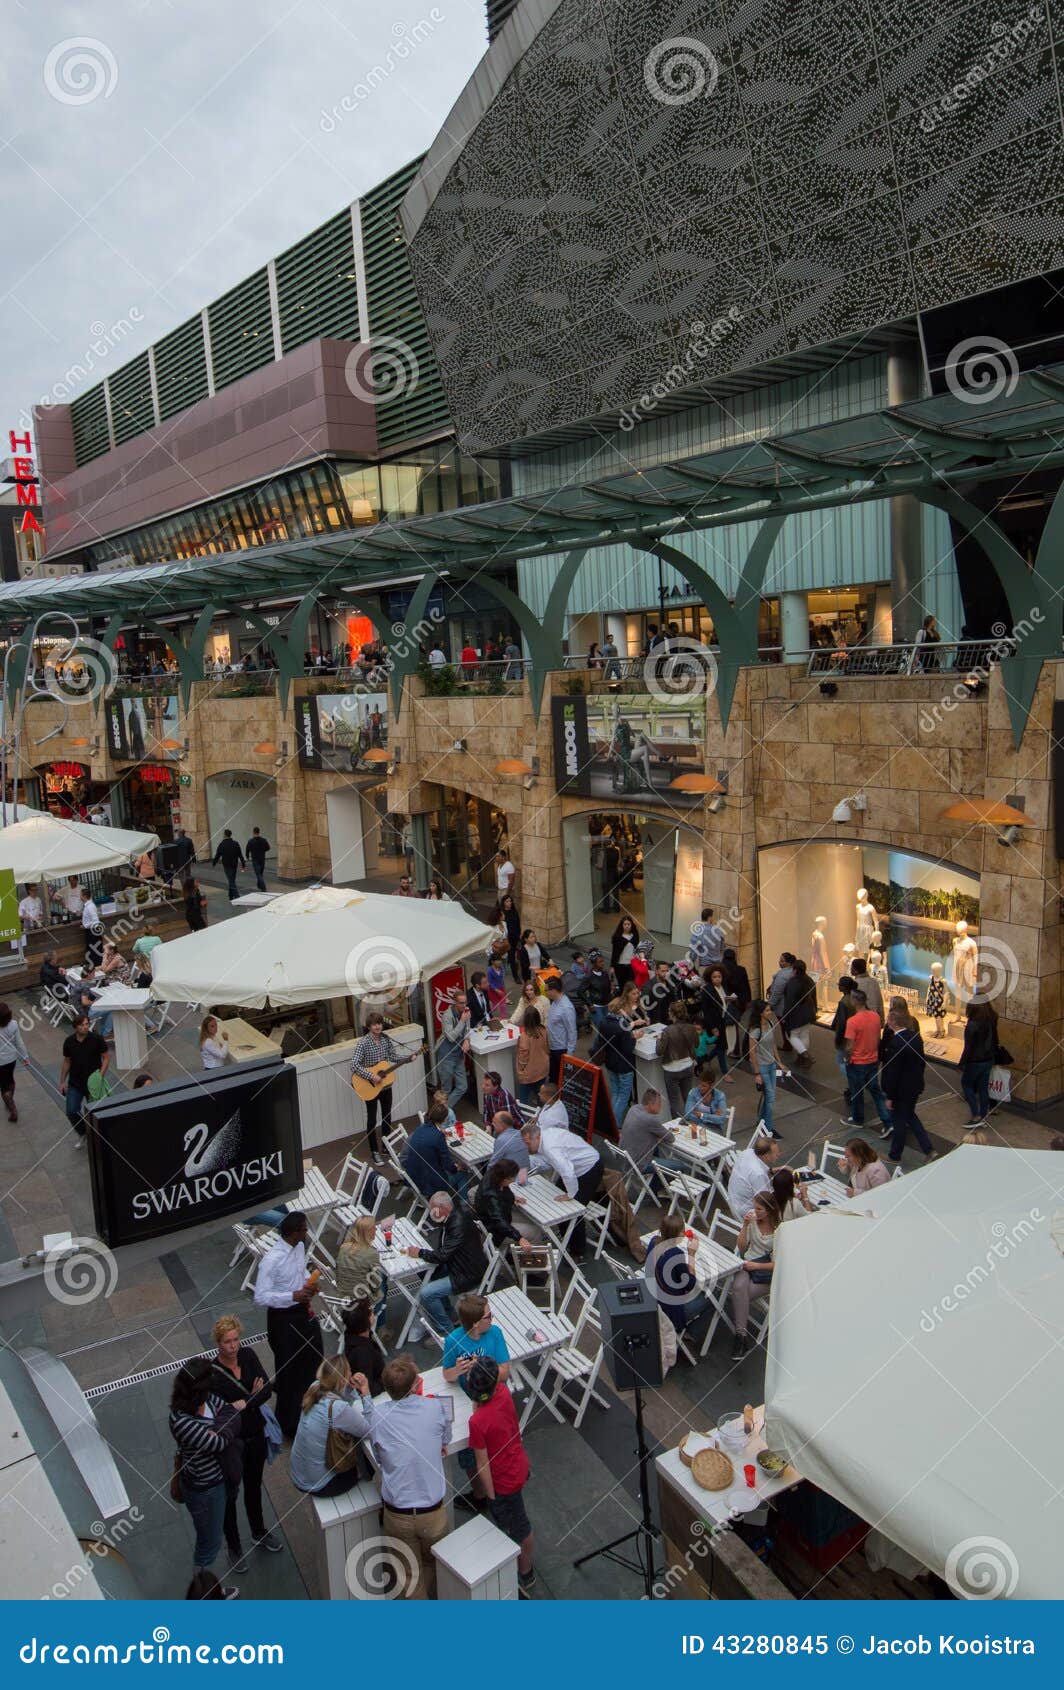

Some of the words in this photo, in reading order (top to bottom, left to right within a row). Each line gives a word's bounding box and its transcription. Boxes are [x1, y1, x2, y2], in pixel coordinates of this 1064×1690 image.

[9, 430, 41, 533] HEMA
[658, 583, 698, 599] ZAR
[132, 1151, 284, 1219] SWAROVSKI
